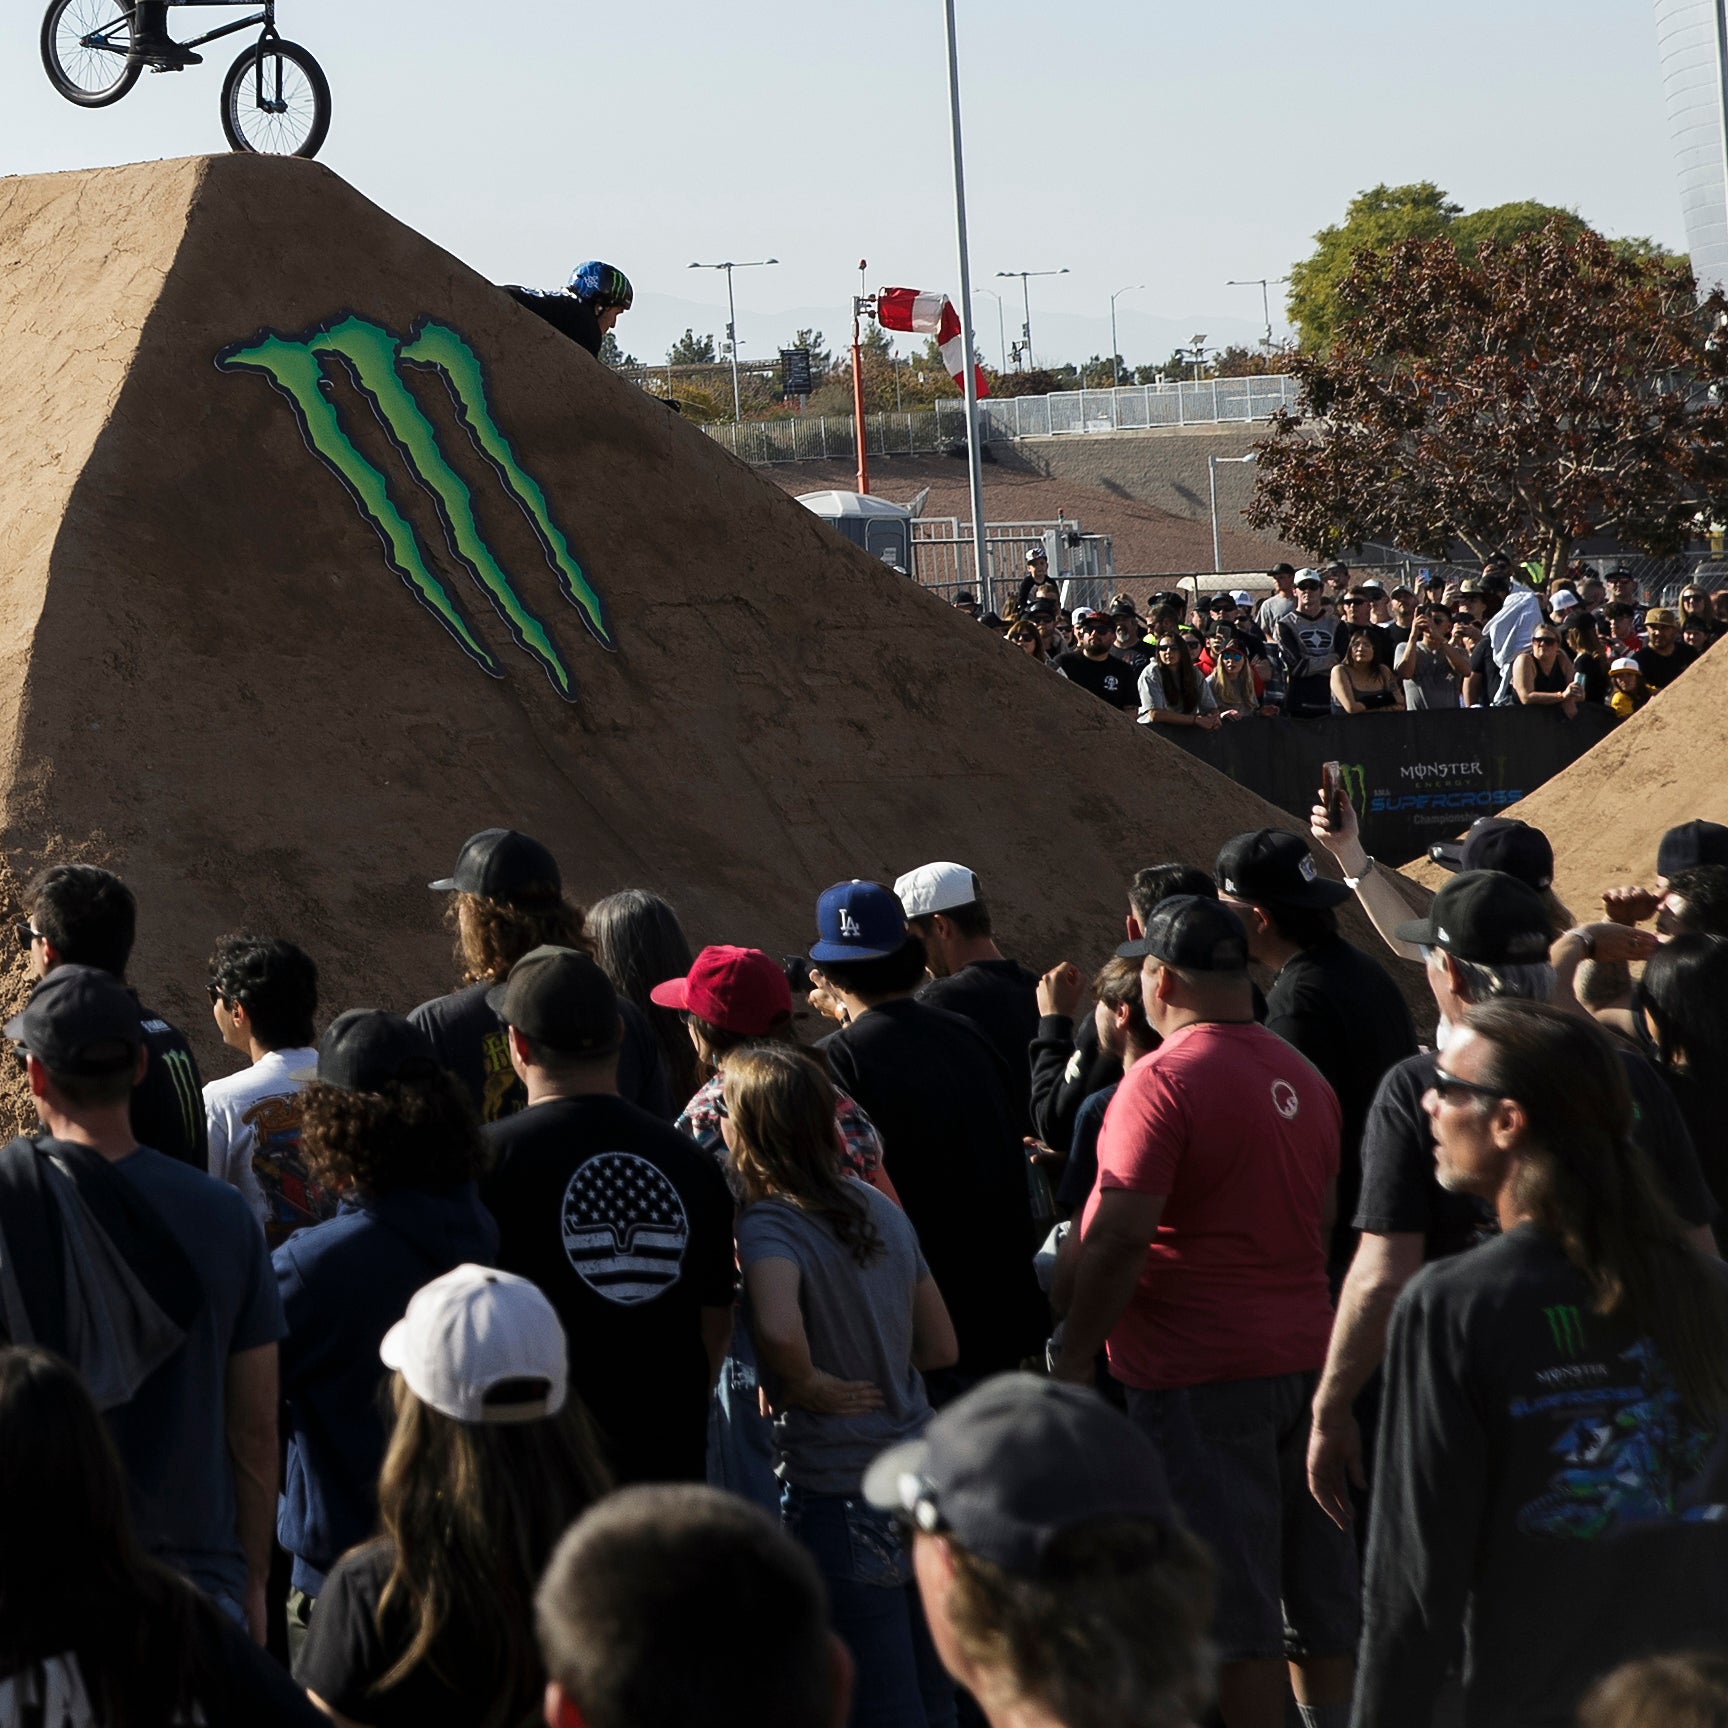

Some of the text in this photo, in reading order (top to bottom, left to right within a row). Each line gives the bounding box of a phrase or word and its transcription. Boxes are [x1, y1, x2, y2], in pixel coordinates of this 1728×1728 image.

[1400, 761, 1483, 780] MONSTER
[1370, 789, 1523, 813] SUPERCROSS
[838, 908, 861, 937] LA
